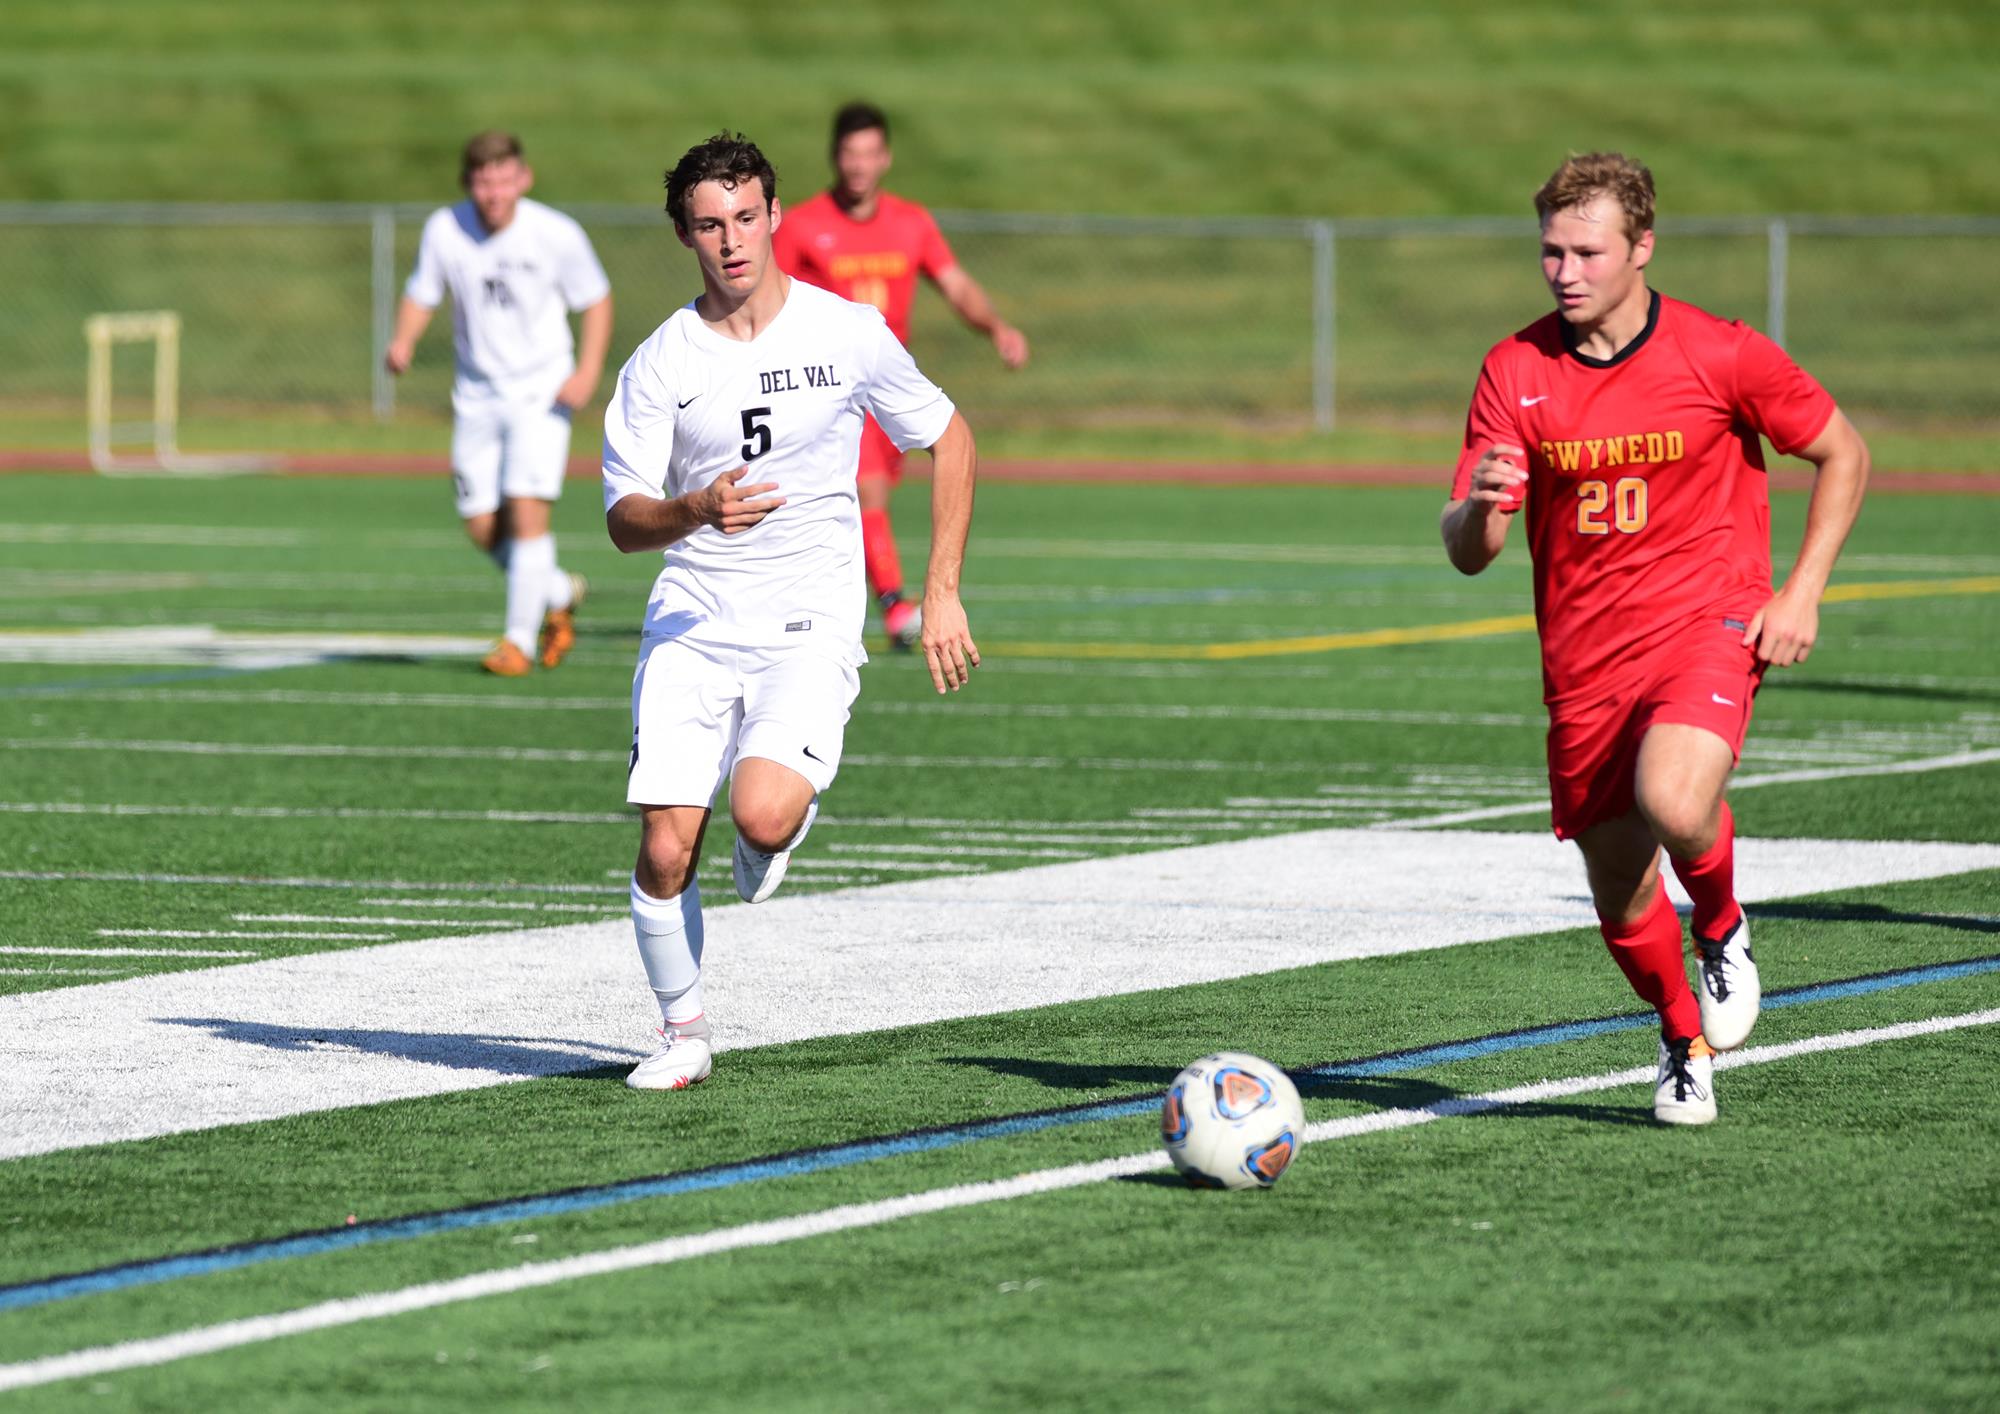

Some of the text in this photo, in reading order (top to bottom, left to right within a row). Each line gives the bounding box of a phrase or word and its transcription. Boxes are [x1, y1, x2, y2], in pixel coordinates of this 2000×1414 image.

[759, 365, 841, 394] DEL VAL
[740, 406, 772, 462] 5
[1541, 430, 1684, 471] GWYNEDD
[1577, 476, 1648, 534] 20
